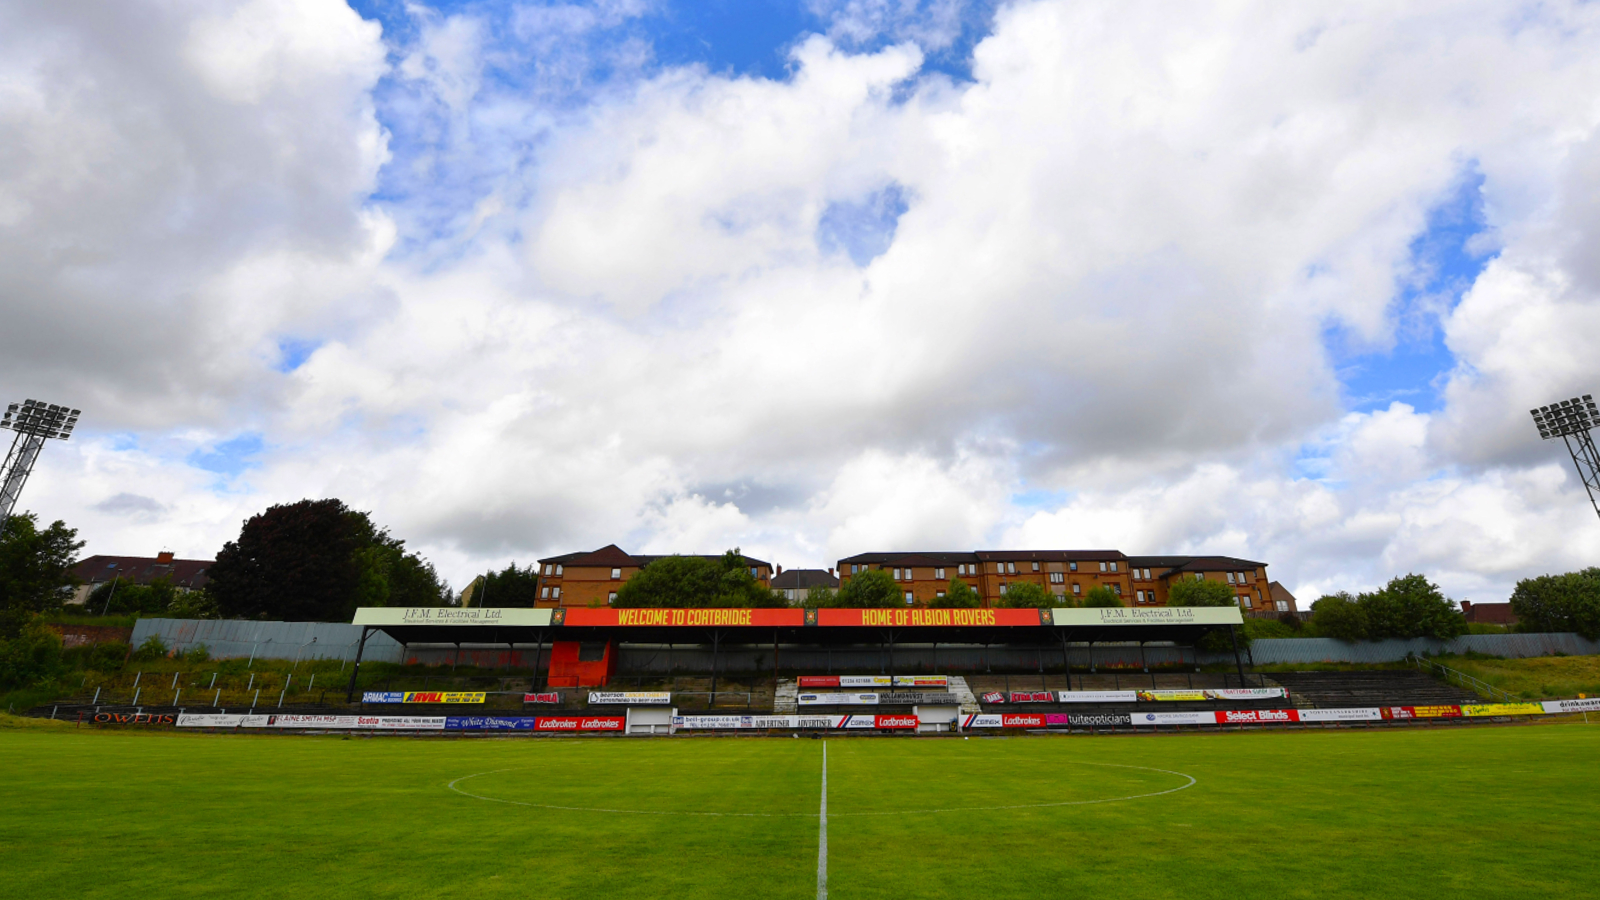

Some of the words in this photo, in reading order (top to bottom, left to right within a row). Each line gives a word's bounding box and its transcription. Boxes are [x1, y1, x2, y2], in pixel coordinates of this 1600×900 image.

[437, 609, 481, 619] Electrical
[485, 609, 503, 619] Ltd.
[619, 610, 669, 625] WELCOME
[672, 610, 685, 625] TO
[688, 610, 752, 625] COATBRIDGE
[862, 610, 893, 625] HOME
[896, 610, 910, 625] OF
[912, 610, 951, 625] ALBION
[954, 610, 996, 625] ROVERS
[1131, 609, 1173, 618] Electrical
[537, 692, 559, 703] COLA
[1032, 692, 1054, 703] COLA
[95, 713, 174, 724] OWENS
[1068, 713, 1131, 725] tuiteopticians
[1226, 710, 1257, 720] Select
[1259, 710, 1289, 720] Blinds
[358, 717, 379, 725] Scotia
[461, 717, 483, 727] White
[485, 717, 519, 728] Diamond
[539, 719, 577, 728] Ladbrokes
[581, 719, 619, 728] Ladbrokes
[755, 720, 790, 728] ADVERTISER
[797, 719, 832, 728] ADVERTISER
[879, 717, 916, 727] Ladbrokes
[1004, 716, 1041, 726] Ladbrokes
